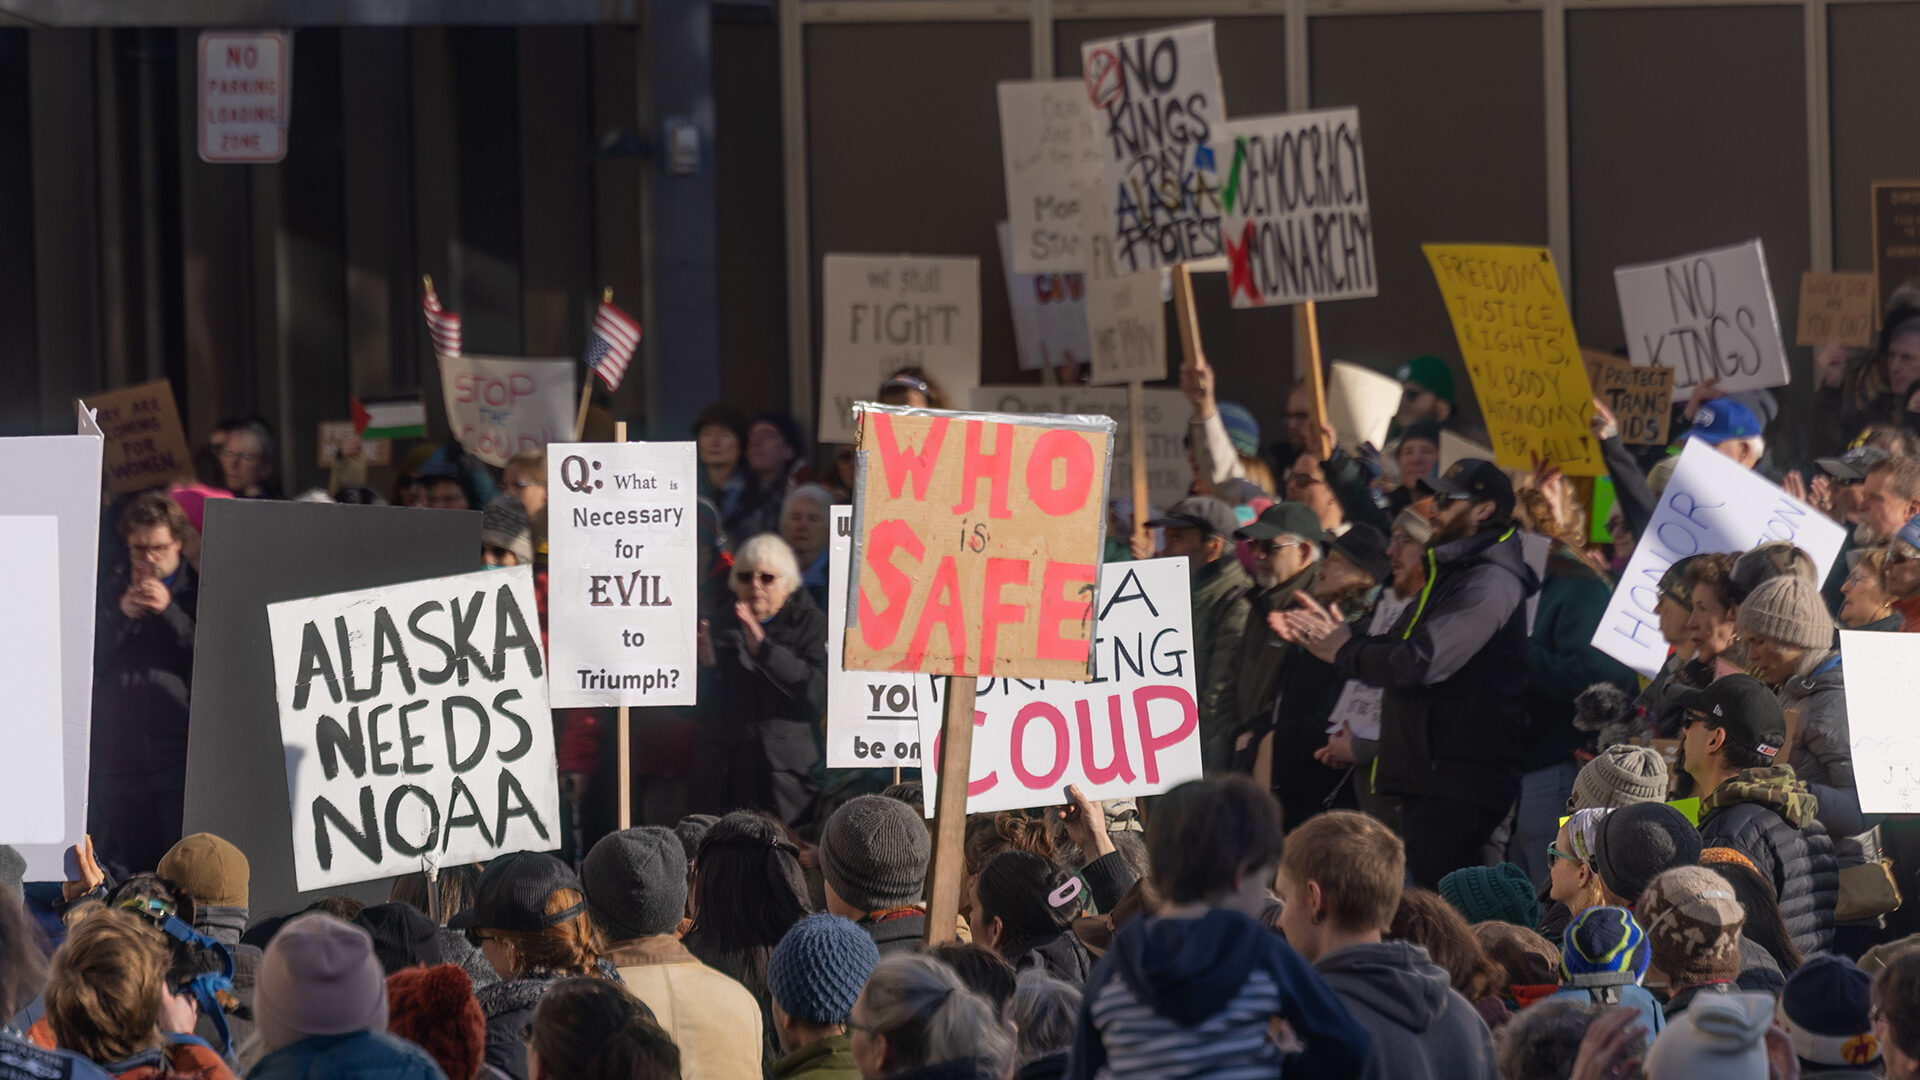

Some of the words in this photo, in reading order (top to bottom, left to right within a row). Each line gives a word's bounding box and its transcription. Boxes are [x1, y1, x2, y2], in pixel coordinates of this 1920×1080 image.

[226, 46, 258, 70] NO
[1118, 36, 1178, 95] NO
[208, 79, 277, 97] PARKING
[208, 106, 277, 124] LOADING
[1107, 94, 1210, 160] KINGS
[221, 134, 261, 152] ZONE
[1236, 121, 1362, 216] DEMOCRACY
[1115, 171, 1221, 238] ALASKA
[1119, 216, 1225, 272] PROTEST
[1665, 258, 1716, 324] NO
[850, 304, 960, 346] FIGHT
[1643, 307, 1760, 389] KINGS
[455, 371, 537, 406] STOP
[1504, 366, 1560, 401] BODY
[1605, 367, 1668, 387] PROTECT
[132, 399, 160, 414] ARE
[1606, 389, 1667, 415] TRANS
[1623, 416, 1659, 441] IDS
[121, 438, 156, 459] FOR
[872, 412, 1095, 519] WHO
[561, 455, 603, 495] Q:
[614, 473, 657, 490] What
[669, 480, 678, 490] is
[573, 507, 683, 527] Necessary
[615, 539, 644, 559] for
[960, 518, 990, 553] is
[588, 570, 672, 606] EVIL
[1614, 492, 1725, 649] HONOR
[292, 584, 543, 711] ALASKA
[622, 629, 645, 647] to
[577, 668, 680, 695] Triumph?
[316, 689, 533, 781] NEEDS
[853, 736, 886, 759] be
[311, 767, 550, 871] NOAA
